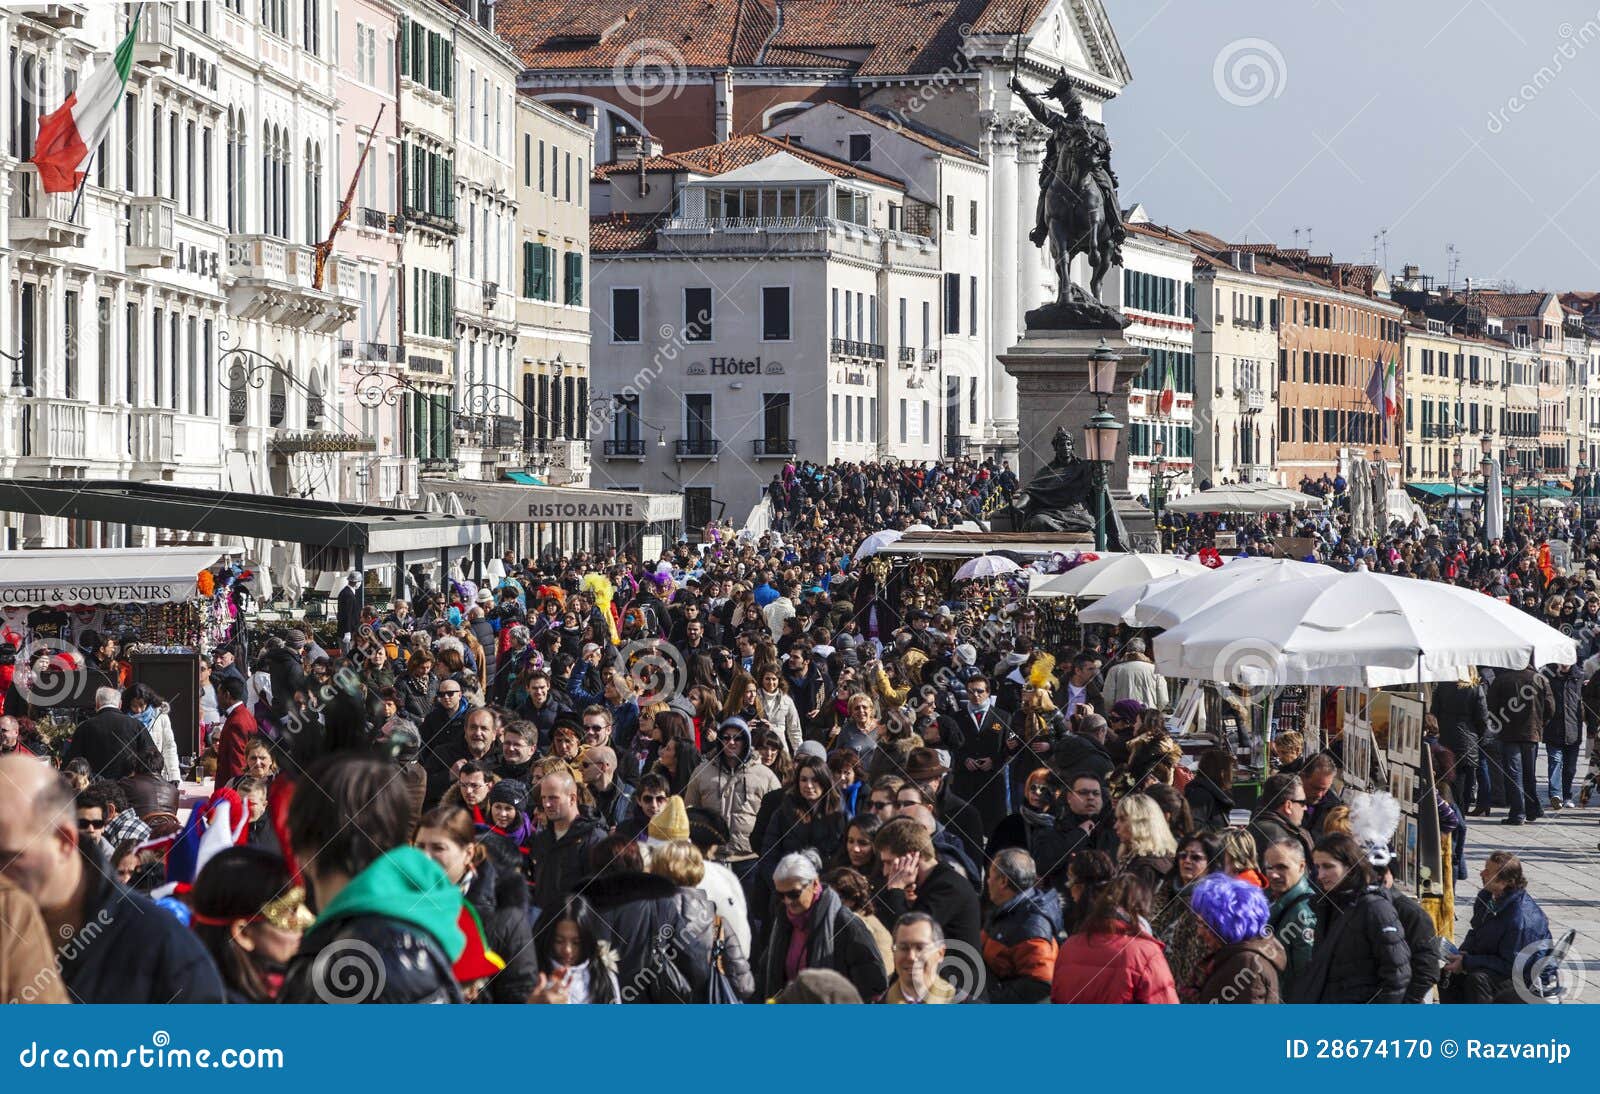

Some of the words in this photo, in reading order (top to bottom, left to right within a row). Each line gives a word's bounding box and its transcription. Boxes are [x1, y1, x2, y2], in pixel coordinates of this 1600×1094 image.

[709, 356, 763, 376] Hôtel
[528, 503, 634, 517] RISTORANTE
[0, 588, 47, 603] CCHI
[51, 588, 63, 602] &
[69, 585, 172, 600] SOUVENIRS
